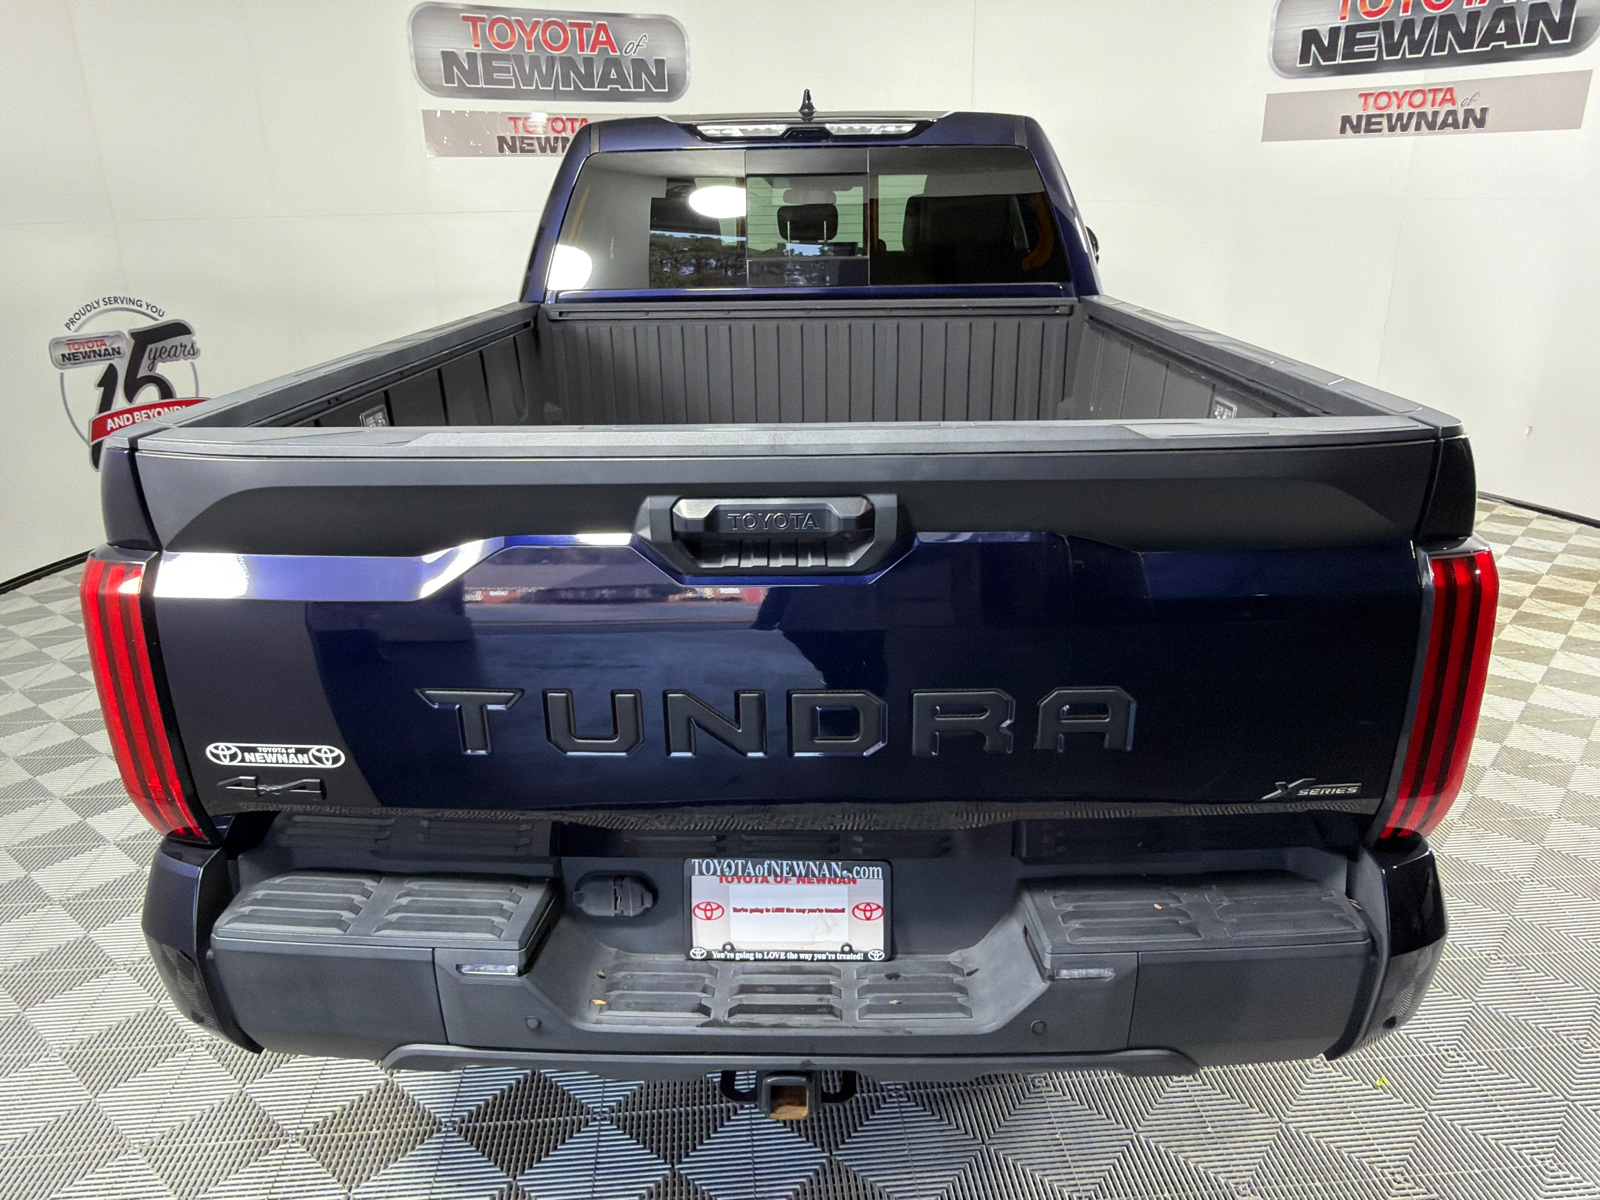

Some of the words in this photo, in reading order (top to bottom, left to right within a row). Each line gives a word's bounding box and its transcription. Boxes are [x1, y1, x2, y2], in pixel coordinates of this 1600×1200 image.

[460, 14, 619, 55] TOYOTA
[623, 34, 648, 55] of
[1297, 0, 1577, 67] NEWNAN
[440, 50, 668, 92] NEWNAN
[1358, 87, 1457, 111] TOYOTA
[1461, 91, 1480, 106] of
[1339, 107, 1489, 135] NEWNAN
[64, 299, 101, 331] PROUDLY
[102, 296, 143, 309] SERVING
[145, 301, 165, 318] YOU
[60, 346, 122, 363] NEWNAN
[65, 339, 107, 352] TOYOTA
[147, 342, 199, 373] years
[106, 413, 133, 432] AND
[727, 513, 820, 530] TOYOTA
[415, 686, 1139, 758] TUNDRA
[244, 752, 310, 765] NEWNAN
[1297, 786, 1359, 797] SERIES
[711, 950, 734, 959] You're
[735, 951, 754, 961] going
[755, 951, 762, 959] to
[763, 951, 786, 960] LOVE
[787, 952, 798, 960] the
[799, 953, 812, 961] way
[813, 952, 835, 961] you're
[836, 952, 864, 960] treated!
